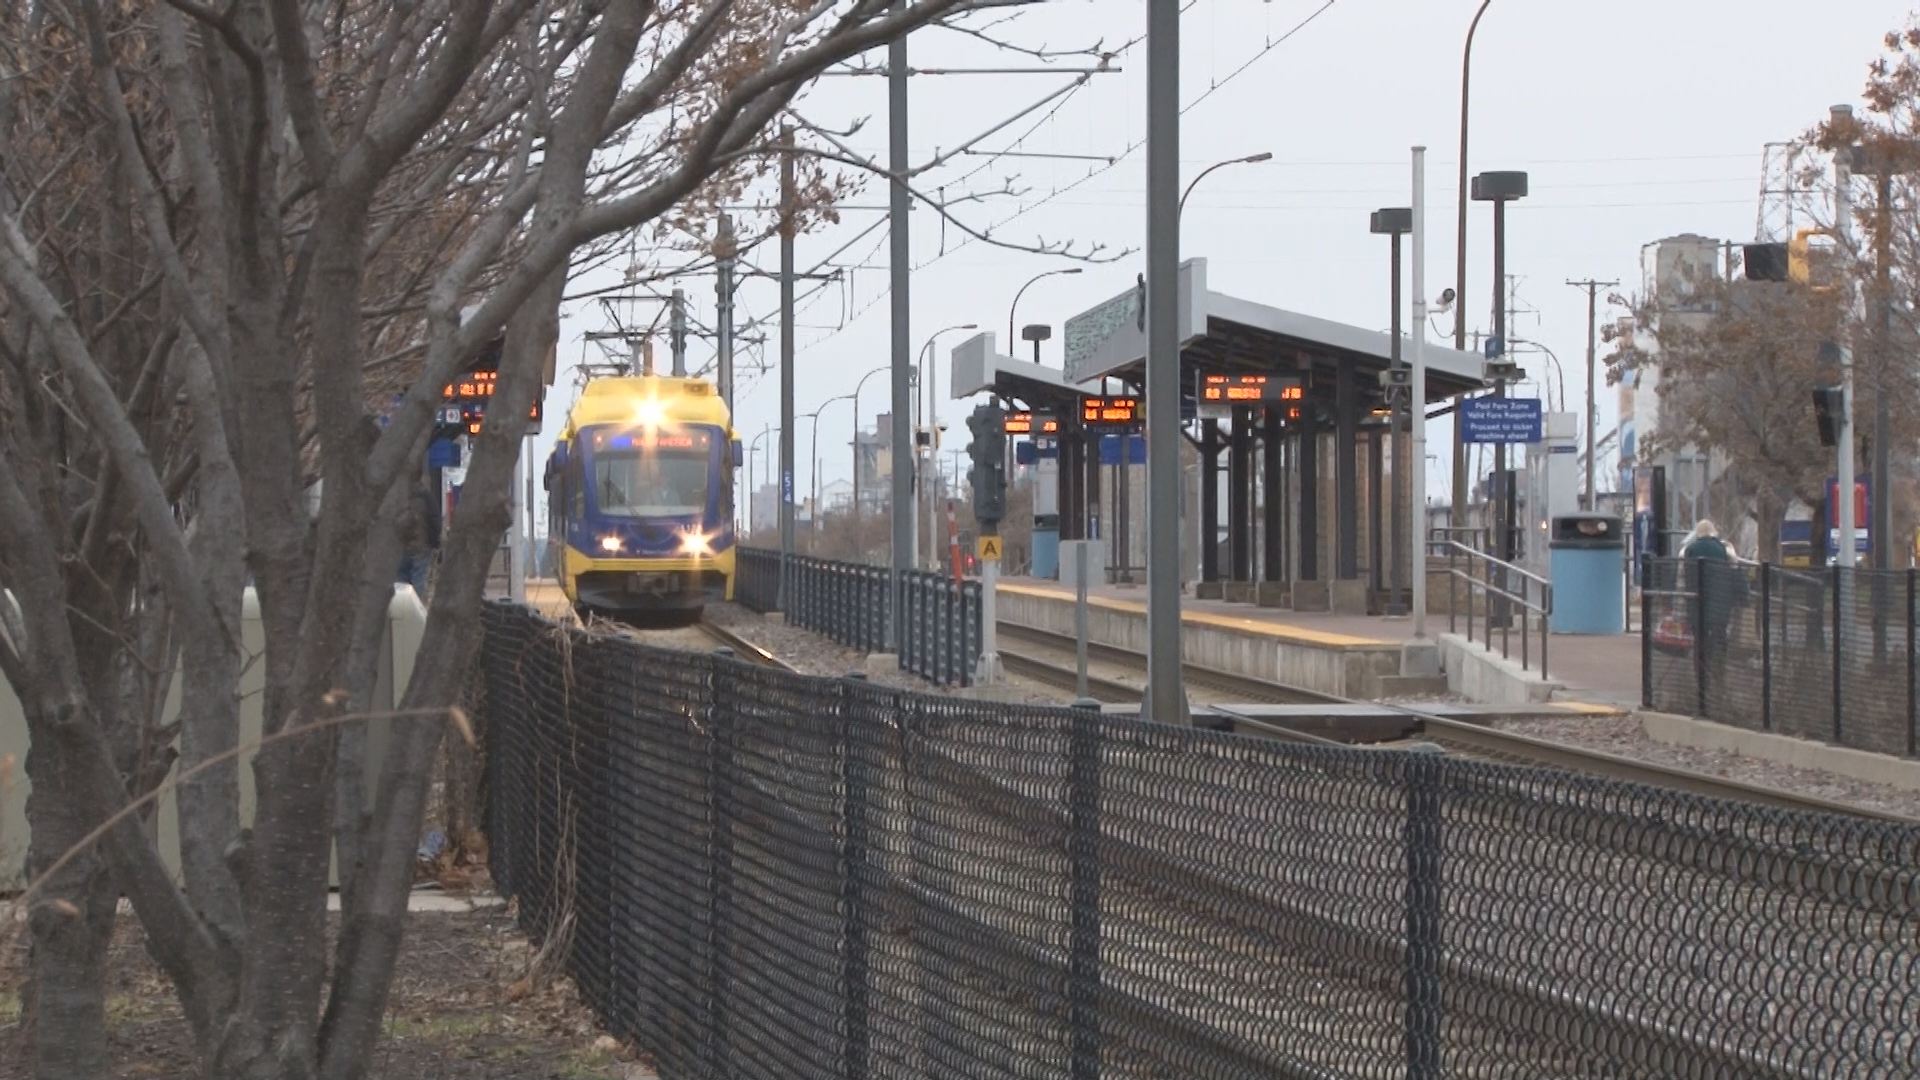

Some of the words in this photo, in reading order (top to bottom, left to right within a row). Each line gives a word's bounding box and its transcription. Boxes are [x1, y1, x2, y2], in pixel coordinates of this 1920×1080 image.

[1492, 402, 1508, 410] Fare
[1510, 402, 1530, 410] Zone
[1467, 411, 1485, 419] Valid
[1486, 411, 1503, 419] Fare
[1504, 411, 1537, 420] Required
[1507, 431, 1529, 440] ahead
[983, 540, 998, 556] A
